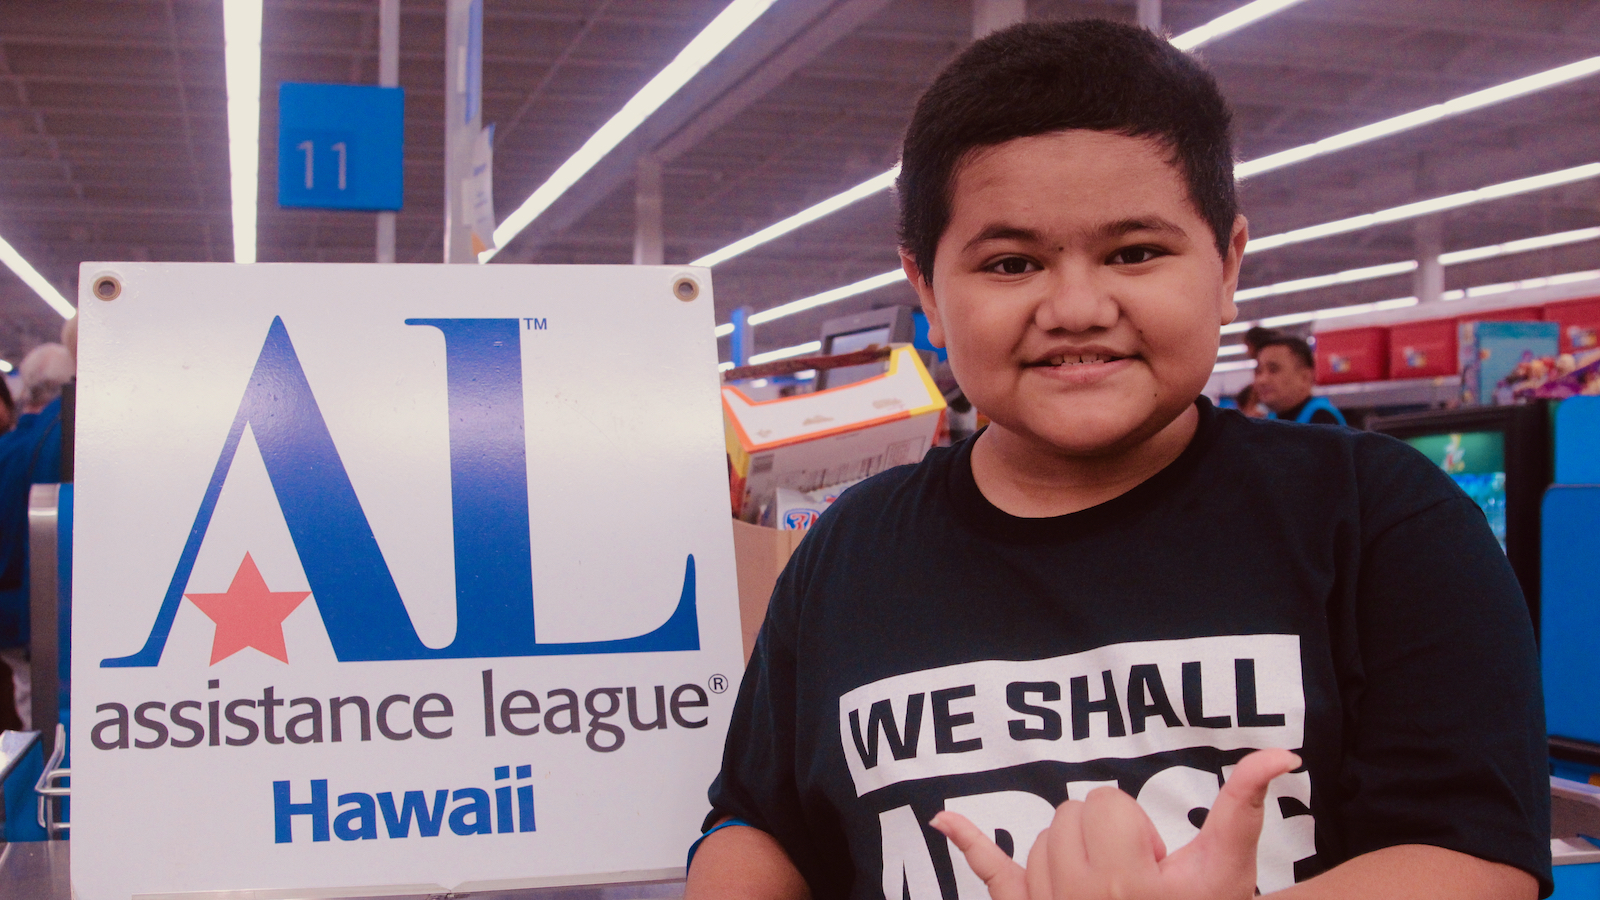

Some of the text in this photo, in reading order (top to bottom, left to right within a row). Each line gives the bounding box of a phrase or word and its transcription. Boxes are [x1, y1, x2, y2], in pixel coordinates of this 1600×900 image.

[296, 140, 347, 190] 11
[100, 314, 700, 669] AL
[90, 678, 454, 751] assistance
[848, 657, 1286, 770] WE SHALL
[272, 764, 537, 844] Hawaii
[878, 762, 1317, 900] ARSE
